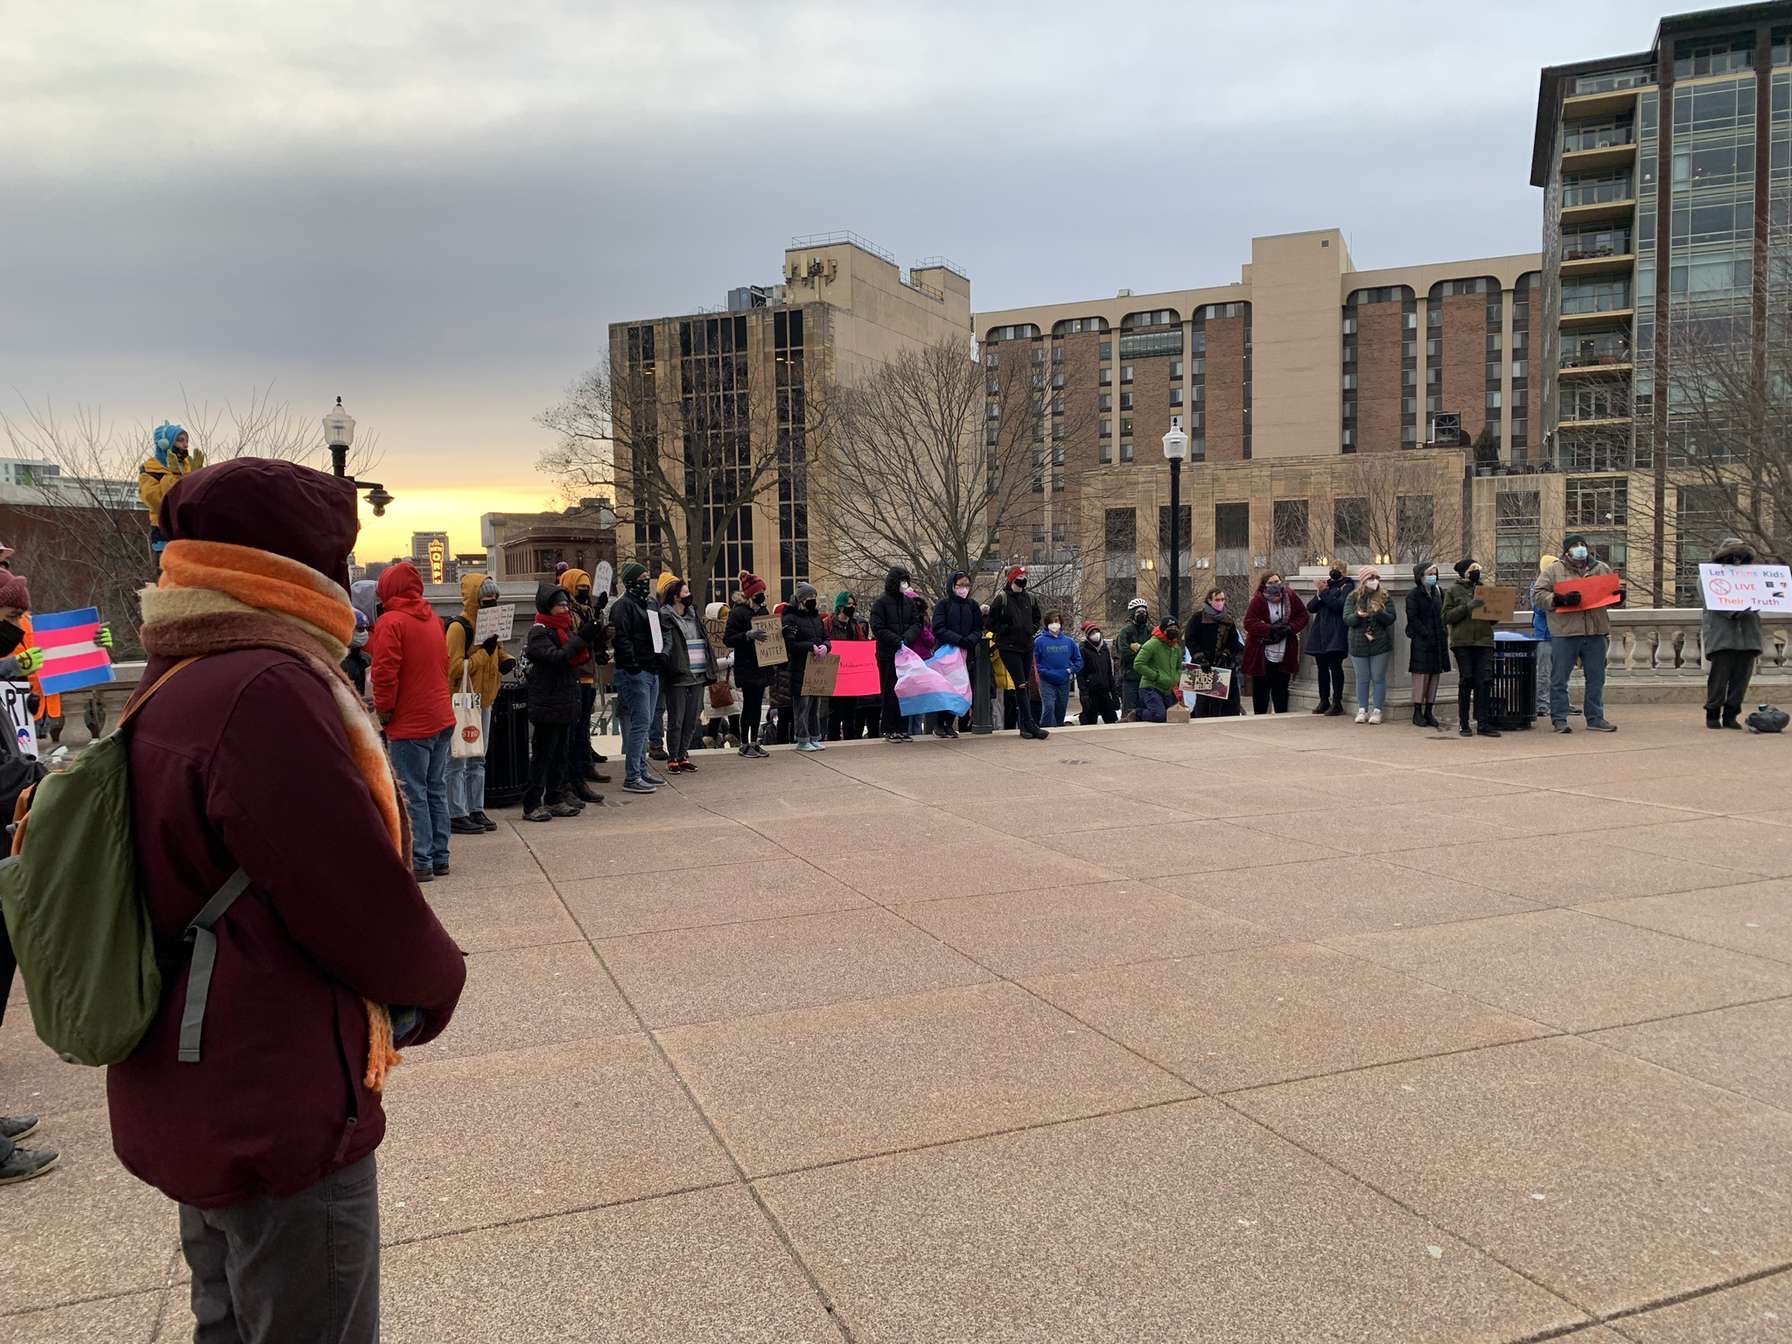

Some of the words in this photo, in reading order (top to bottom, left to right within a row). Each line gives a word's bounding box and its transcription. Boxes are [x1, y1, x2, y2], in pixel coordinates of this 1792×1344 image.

[1708, 569, 1725, 577] Let
[1763, 570, 1785, 578] Kids
[1734, 583, 1757, 591] LIVE
[1719, 597, 1744, 605] Their
[1752, 598, 1780, 606] Truth
[0, 687, 33, 727] RT
